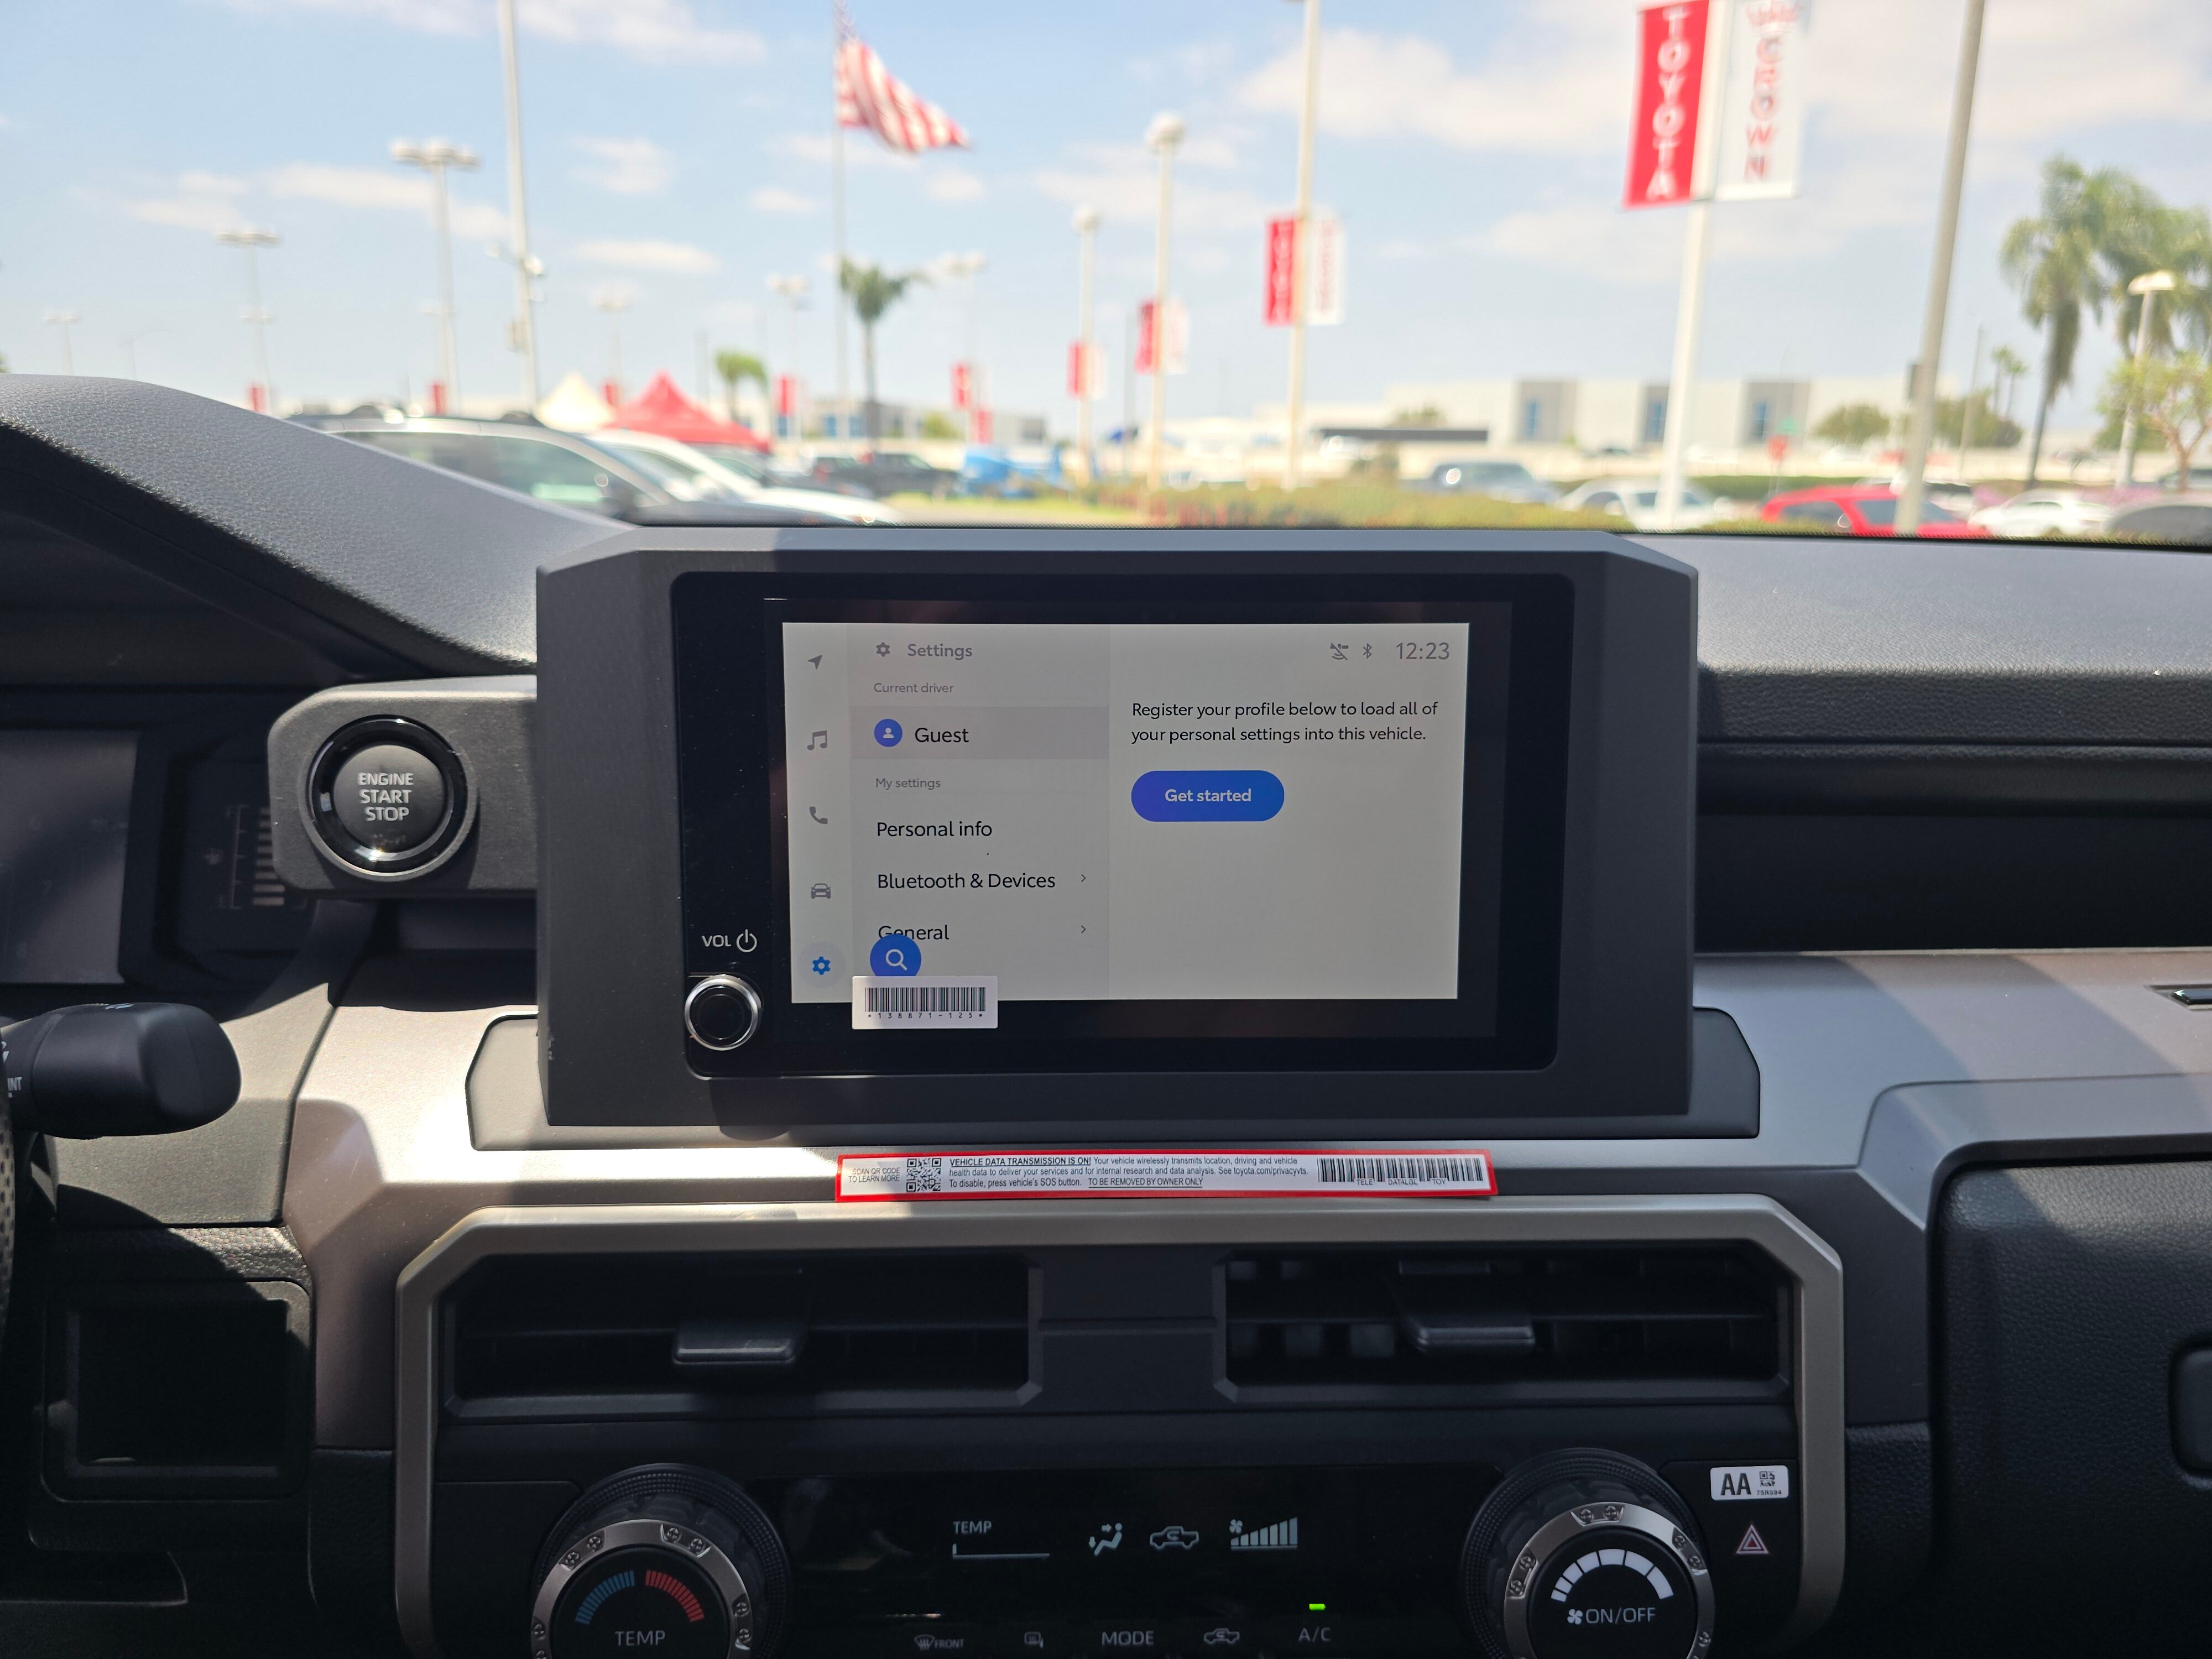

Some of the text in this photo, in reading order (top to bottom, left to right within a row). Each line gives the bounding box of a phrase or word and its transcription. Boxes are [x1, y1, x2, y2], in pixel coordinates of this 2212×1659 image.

[1646, 2, 1691, 201] TOYOTA
[907, 644, 973, 660] Settings
[1396, 642, 1450, 660] 12:23
[874, 683, 954, 693] Current driver
[1132, 701, 1438, 719] Register your profile below to load all of
[915, 727, 969, 744] Guest
[1131, 727, 1426, 744] your personal settings into this vehicle.
[357, 773, 414, 786] ENGINE
[876, 778, 941, 790] My settings
[359, 789, 412, 804] START
[1165, 788, 1251, 802] Get started
[364, 807, 409, 821] STOP
[877, 821, 992, 837] Personal info
[878, 873, 1056, 889] Bluetooth & Devices
[701, 935, 731, 947] VOL
[1136, 1157, 1169, 1166] wirelessly
[1204, 1156, 1233, 1165] location,
[1234, 1156, 1257, 1166] driving
[950, 1168, 970, 1176] health
[1187, 1166, 1216, 1176] analysis.
[1234, 1166, 1308, 1176] toyota.com/privacyvts.
[950, 1179, 957, 1187] To
[959, 1178, 986, 1188] disable,
[988, 1180, 1006, 1188] press
[1009, 1178, 1038, 1186] vehicle's
[1058, 1177, 1082, 1186] button.
[1720, 1473, 1752, 1495] AA
[953, 1521, 992, 1534] TEMP
[1585, 1607, 1656, 1624] ON/OFF
[614, 1630, 666, 1646] TEMP
[1102, 1631, 1154, 1646] MODE
[1298, 1626, 1331, 1642] A/C
[935, 1638, 964, 1648] FRONT
